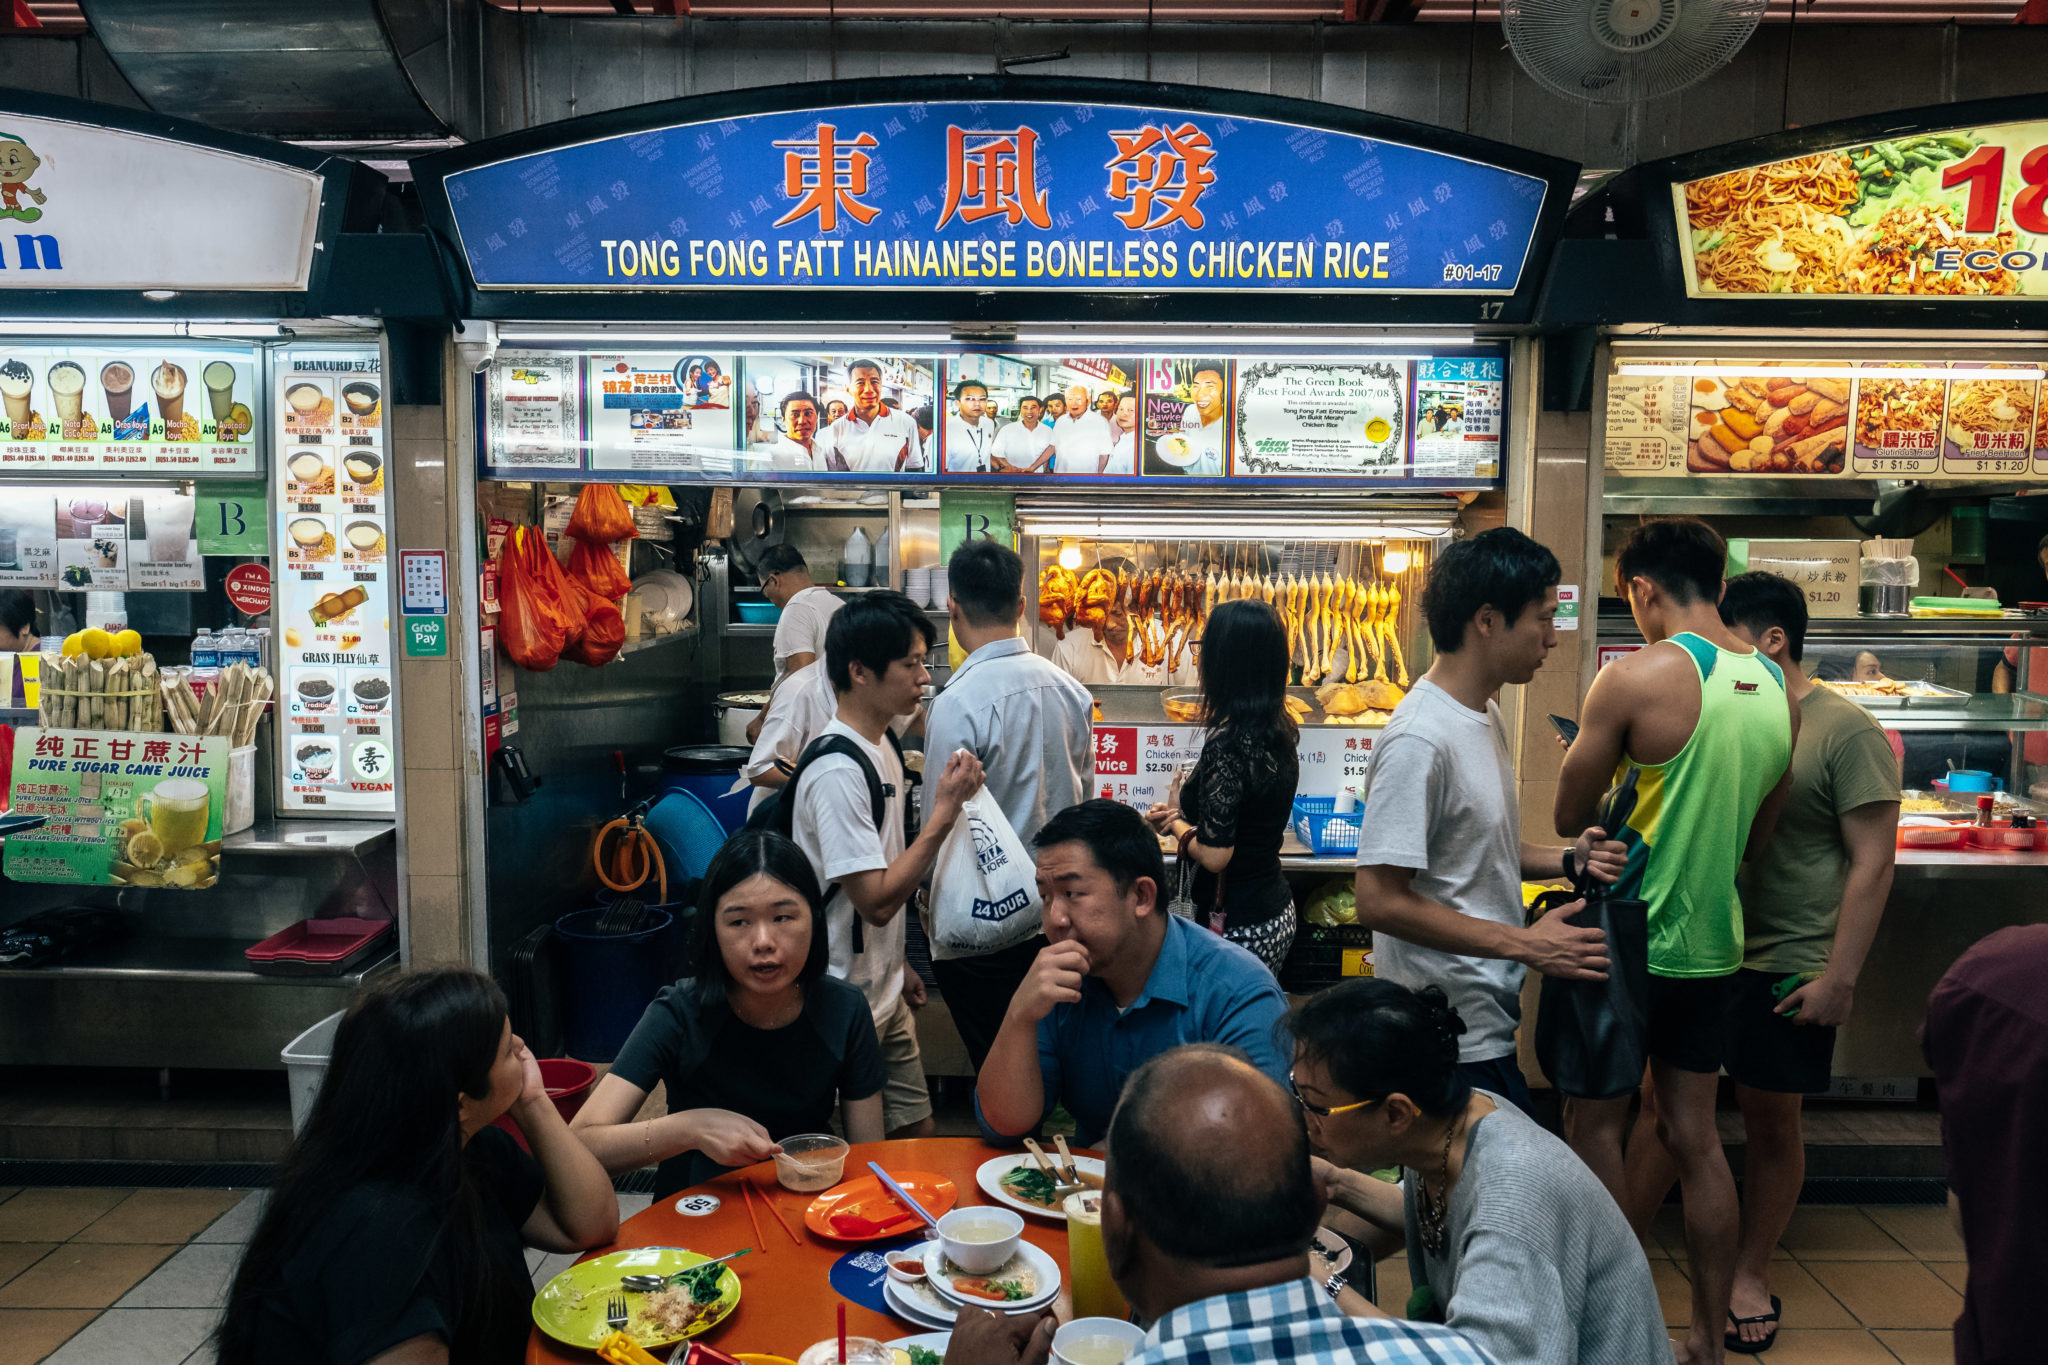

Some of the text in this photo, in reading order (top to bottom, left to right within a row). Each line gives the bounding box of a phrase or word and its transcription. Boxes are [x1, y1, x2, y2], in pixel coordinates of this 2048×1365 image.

[771, 122, 1219, 233] 東風發
[600, 239, 1390, 280] TONG FONG FATT HAINANESE BONELESS CHICKEN RICE
[1443, 265, 1503, 281] #01-17
[1479, 302, 1505, 322] 17
[293, 360, 352, 372] BEANCURD
[1418, 360, 1502, 380] 联合晚报
[634, 373, 672, 385] 荷兰村
[1285, 376, 1364, 387] The Green Book
[602, 379, 633, 394] 锦茂
[634, 385, 677, 394] 美食的宝藏
[1258, 387, 1390, 399] Best Food Awards 2007/08
[1147, 397, 1185, 414] New
[1465, 400, 1483, 408] 海南
[1283, 407, 1299, 416] Tong
[1299, 407, 1315, 416] Fong
[1328, 408, 1358, 416] Enterprise
[50, 423, 60, 434] A7
[101, 423, 112, 434] A8
[152, 420, 188, 435] A9 Mocha
[203, 421, 247, 435] A10 Avocado
[1147, 420, 1201, 430] Generation
[1301, 421, 1325, 429] Chicken
[300, 435, 320, 443] $1.00
[351, 437, 371, 445] $1.40
[1255, 440, 1290, 448] GREEN
[1881, 431, 1937, 449] 糯米饭
[1973, 431, 2026, 450] 炒米粉
[1259, 446, 1290, 454] BOOK
[1876, 448, 1936, 457] Glutinous Rice
[1964, 448, 1987, 457] Fried
[1871, 459, 1920, 471] $1 $1.50
[1976, 460, 2025, 472] $1 $1.20
[300, 504, 319, 512] $1.20
[355, 505, 374, 513] $1.50
[218, 502, 246, 536] B
[965, 513, 990, 542] B
[24, 547, 51, 557] 黑芝麻
[30, 560, 48, 569] 豆奶
[302, 572, 322, 580] $1.50
[355, 573, 375, 581] $1.50
[1807, 570, 1848, 583] 炒米粉
[180, 579, 201, 588] $1.50
[236, 596, 270, 606] MERCHANT
[1808, 591, 1841, 602] $1.20
[411, 620, 440, 633] Grab
[342, 635, 361, 643] $1.00
[415, 633, 438, 646] Pay
[302, 652, 380, 666] GRASS JELLY 仙草
[303, 701, 338, 709] Traditional
[303, 725, 323, 733] $1.00
[1146, 734, 1175, 747] 鸡饭
[35, 734, 207, 765] 纯正甘蔗汁
[1145, 749, 1182, 760] Chicken
[358, 746, 385, 774] 素
[1094, 758, 1128, 772] vice
[28, 759, 211, 780] PURE SUGAR CANE JUICE
[1145, 763, 1173, 773] $2.50
[16, 783, 70, 796] 纯正甘蔗汁
[351, 782, 393, 791] VEGAN
[1132, 785, 1155, 797] (Half)
[15, 803, 68, 815] 甘蔗汁无冰
[974, 902, 992, 917] 24
